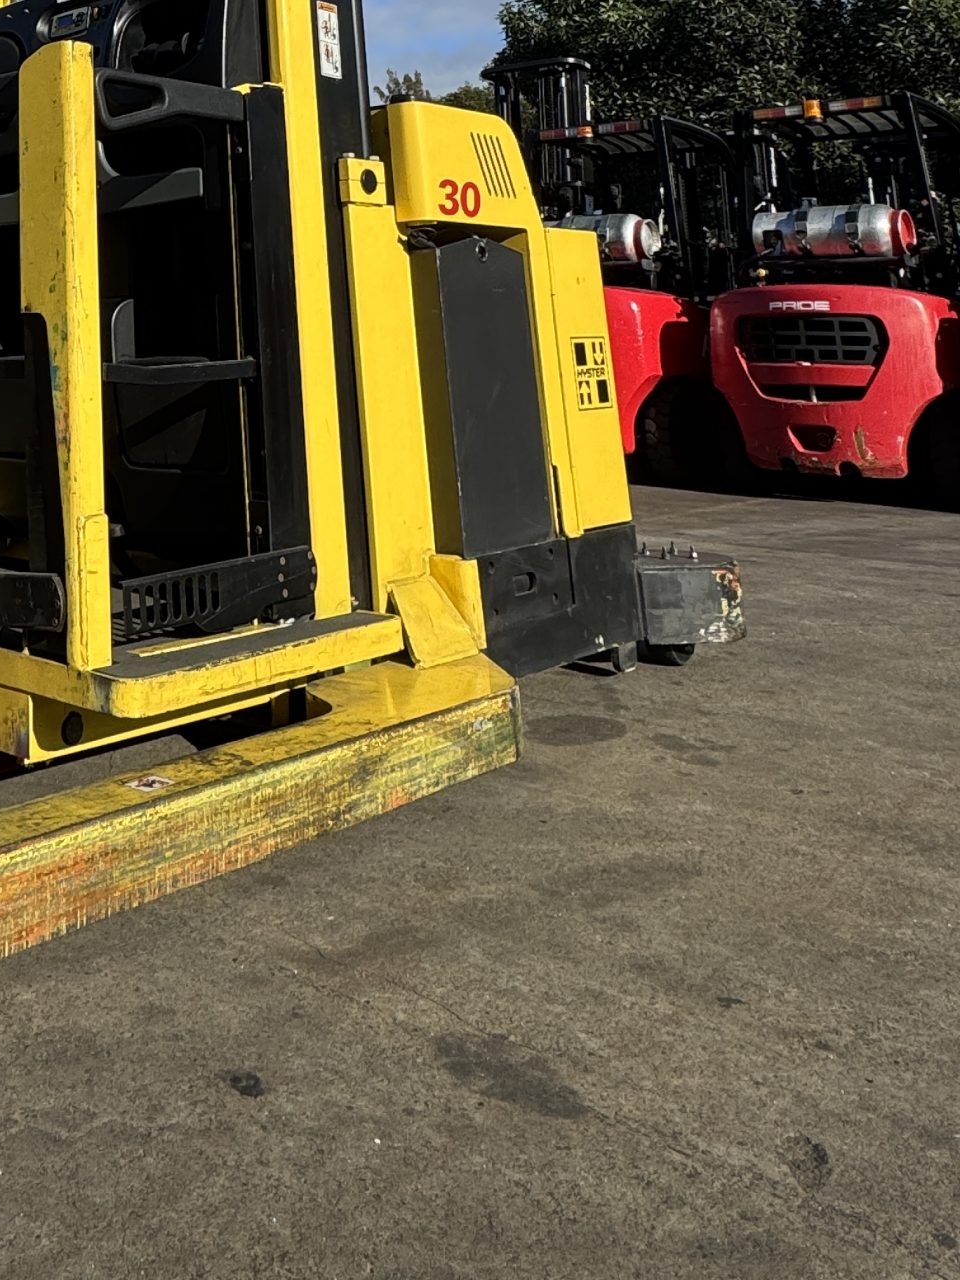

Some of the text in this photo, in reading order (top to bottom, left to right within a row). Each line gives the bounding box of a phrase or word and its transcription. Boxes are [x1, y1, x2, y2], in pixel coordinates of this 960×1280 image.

[438, 179, 481, 218] 30
[769, 300, 830, 311] PRIDE
[577, 367, 606, 379] HYSTER
